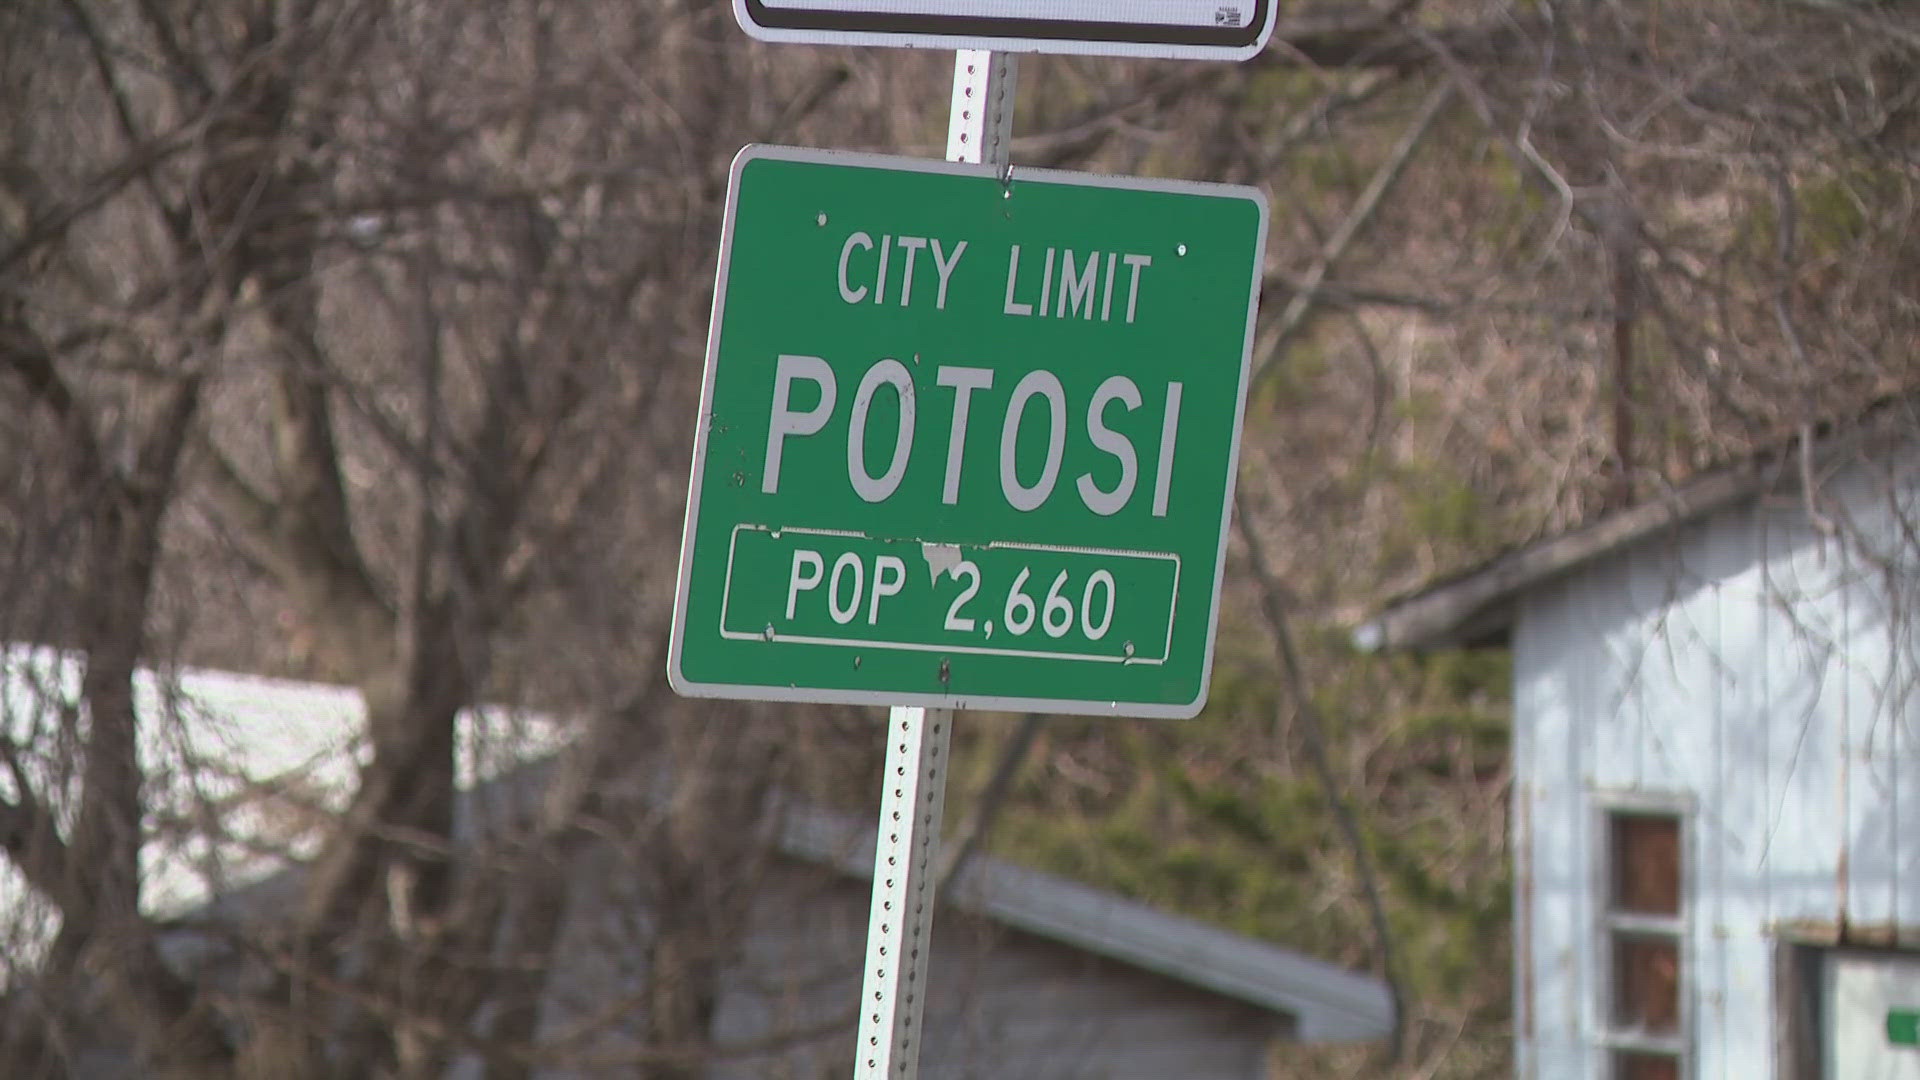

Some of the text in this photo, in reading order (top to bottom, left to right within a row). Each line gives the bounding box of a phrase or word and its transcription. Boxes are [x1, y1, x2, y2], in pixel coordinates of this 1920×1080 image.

[837, 231, 1152, 323] CITY LIMIT
[761, 354, 1183, 518] POTOSI
[785, 549, 1116, 641] POP 2,660
